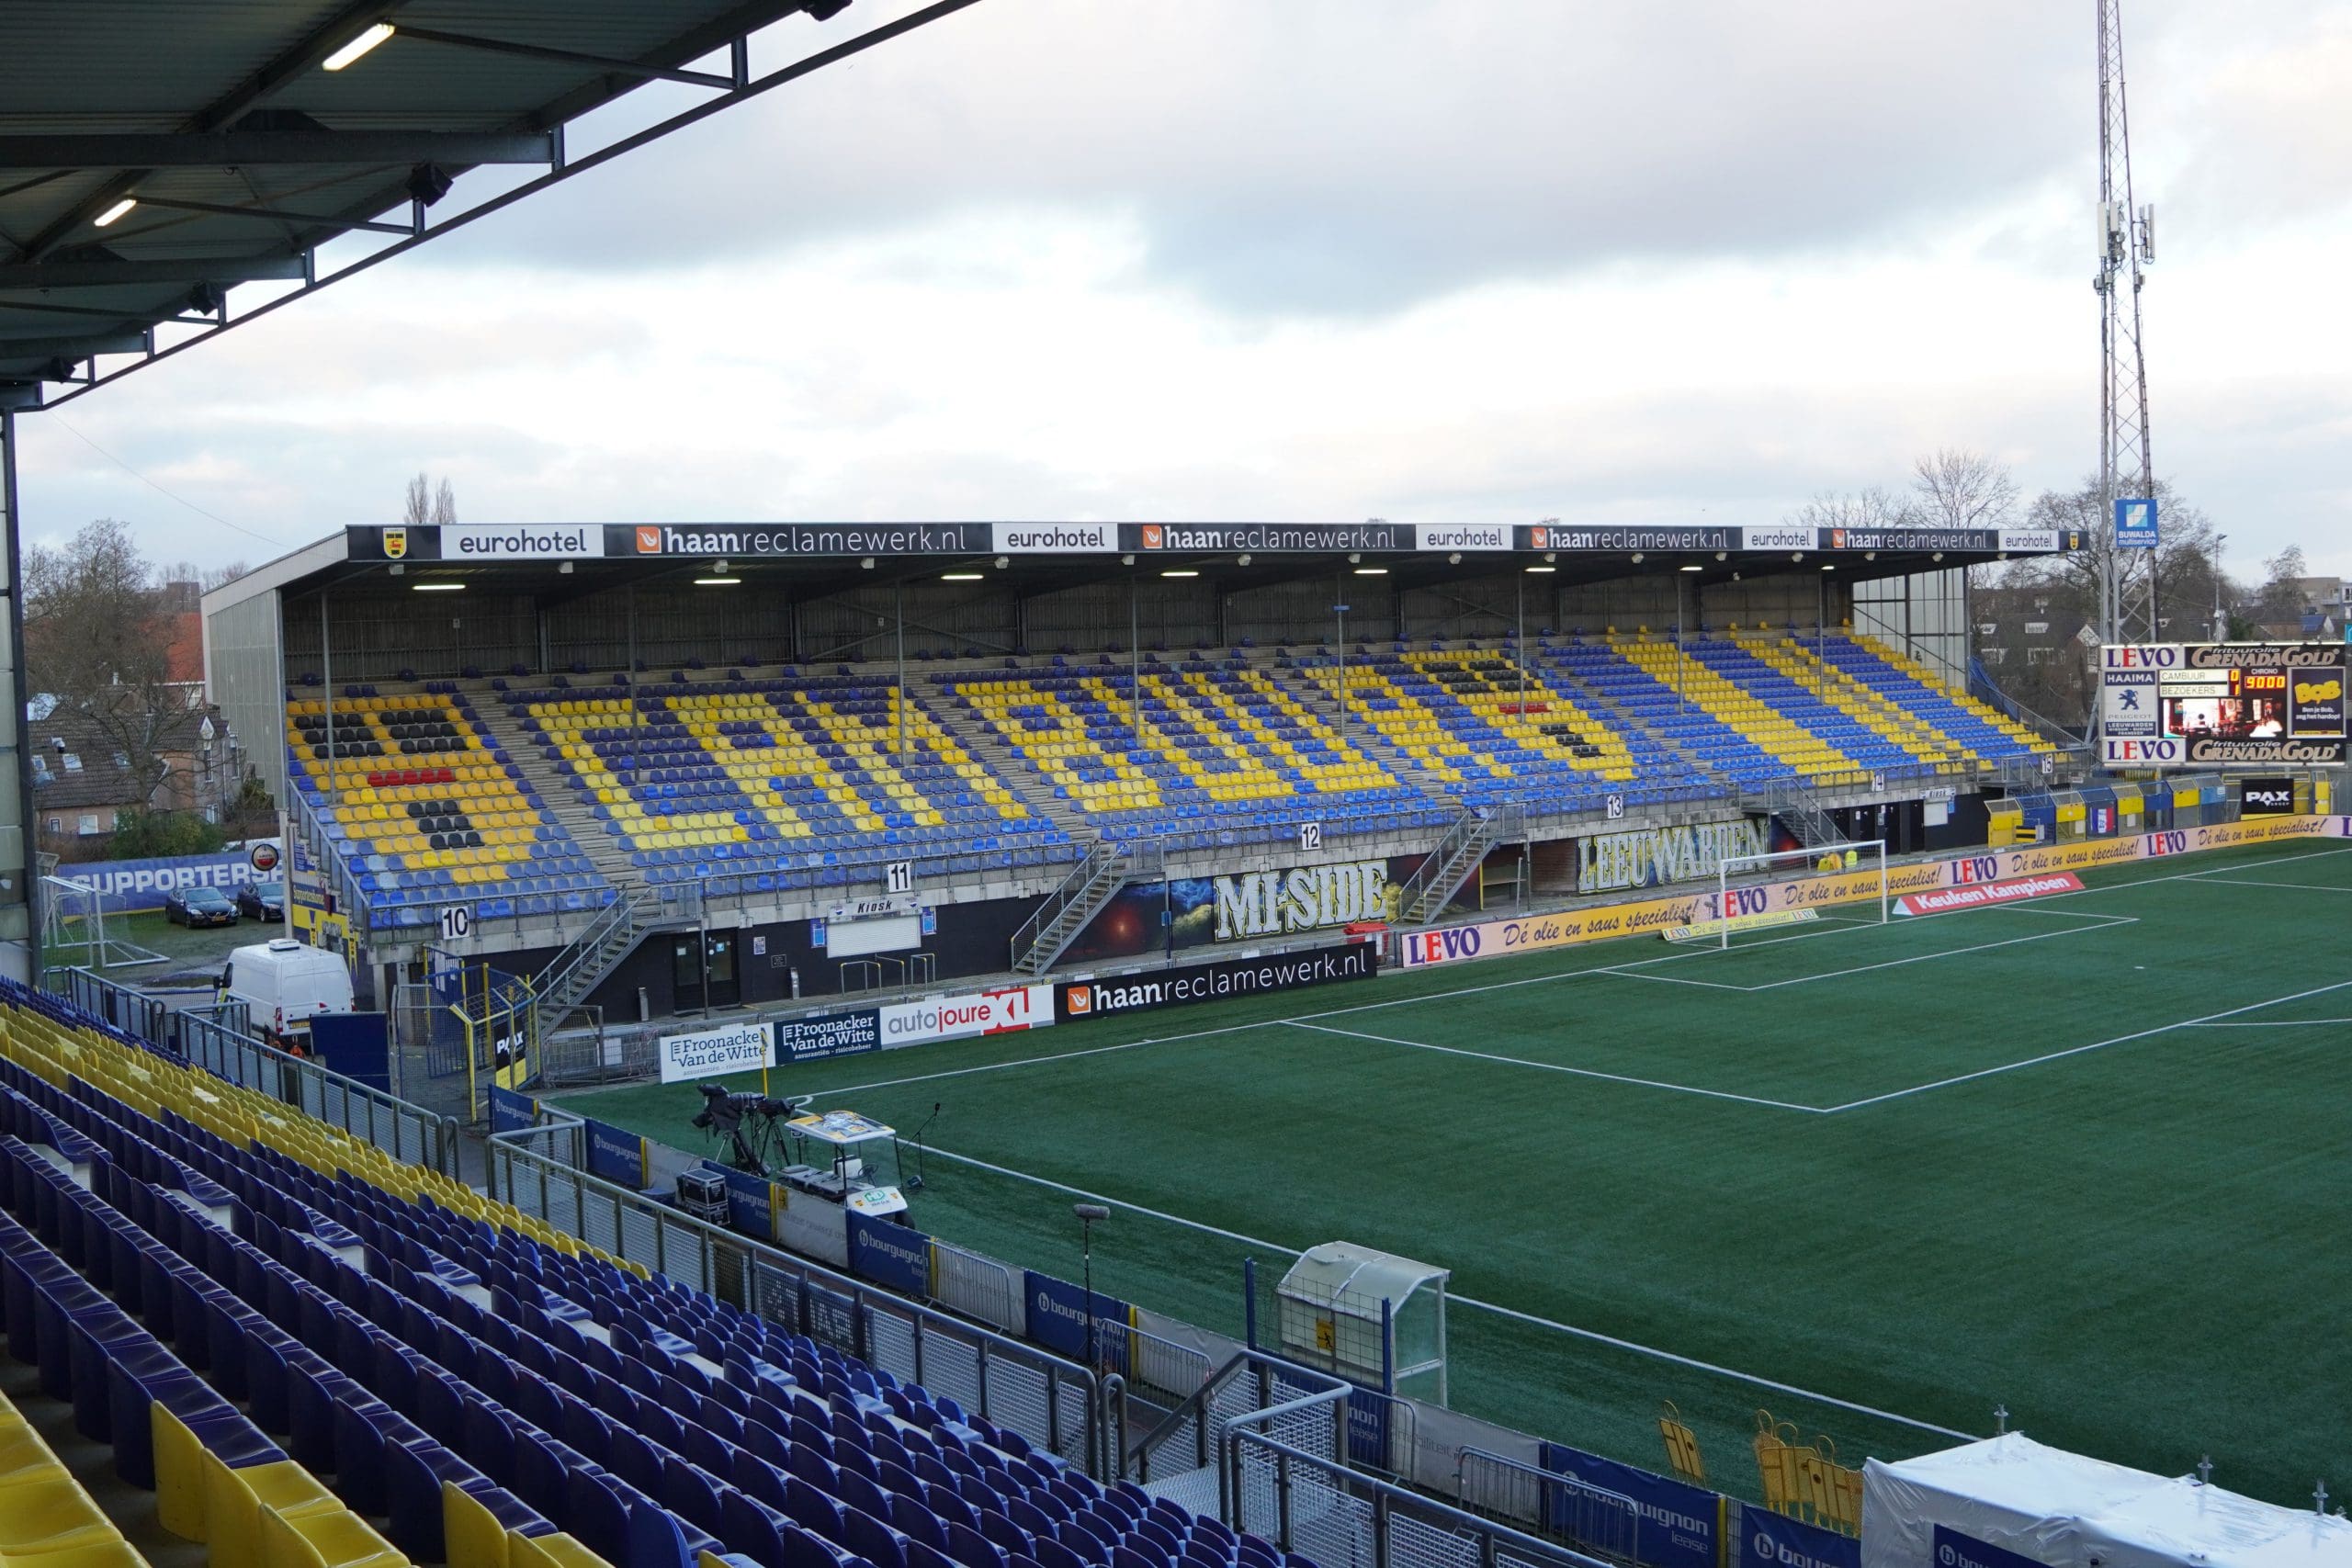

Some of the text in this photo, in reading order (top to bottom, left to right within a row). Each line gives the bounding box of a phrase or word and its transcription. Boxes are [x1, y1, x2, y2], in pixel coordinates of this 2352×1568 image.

[459, 529, 587, 553] eurohotel
[664, 525, 966, 553] haanreclamewerk.nl
[1007, 526, 1105, 547] eurohotel
[1164, 525, 1396, 549] haanreclamewerk.nl
[1427, 527, 1503, 547] eurohotel
[1548, 527, 1727, 549] haanreclamewerk.nl
[1751, 529, 1810, 547] eurohotel
[1845, 530, 1987, 549] haanreclamewerk.nl
[2006, 532, 2052, 547] eurohotel
[2107, 648, 2176, 668] LEVO
[2211, 647, 2280, 655] frituurolie
[2107, 673, 2154, 683] HAAIMA
[2161, 670, 2240, 682] CAMBUUR 0
[2161, 686, 2216, 695] BEZOEKERS
[2108, 740, 2176, 761] LEVO
[2042, 754, 2052, 773] 15
[1609, 795, 1623, 817] 13
[2245, 791, 2290, 805] PAX
[1302, 825, 1319, 848] 12
[2146, 829, 2187, 856] LEVO
[2198, 829, 2212, 846] Dé
[2214, 829, 2230, 843] olie
[2232, 830, 2242, 840] en
[2267, 818, 2328, 841] specialist!
[1578, 818, 1770, 894] LEEUWARDEN
[1951, 855, 1998, 885] LEVO
[2011, 853, 2029, 874] Dé
[2031, 853, 2049, 869] olie
[2052, 855, 2063, 865] en
[2091, 838, 2140, 866] specialist!
[890, 864, 908, 890] 11
[1213, 859, 1389, 942] MI-SIDE
[1711, 887, 1768, 920] LEVO
[1785, 884, 1805, 905] Dé
[1808, 881, 1830, 900] olie
[1834, 886, 1848, 897] en
[1914, 877, 2071, 909] Keuken Kampioen
[857, 899, 893, 914] Kiosk
[444, 908, 469, 937] 10
[1408, 925, 1481, 964] LEVO
[1503, 922, 1529, 947] Dé
[1533, 920, 1559, 942] olie
[1565, 923, 1581, 937] en
[1625, 897, 1700, 935] specialist!
[1664, 927, 1690, 941] LEVO
[1093, 948, 1366, 1011] haanreclamewerk.nl
[793, 1015, 875, 1037] Froonacker
[683, 1031, 765, 1053] Froonacke
[790, 1029, 875, 1052] Van de Witte
[677, 1045, 767, 1067] Van de Witte
[500, 1102, 534, 1122] bourguignon
[601, 1137, 641, 1161] bourguignon
[727, 1185, 770, 1210] ourguignon
[869, 1234, 929, 1266] bourguignon
[1671, 1530, 1709, 1555] lease
